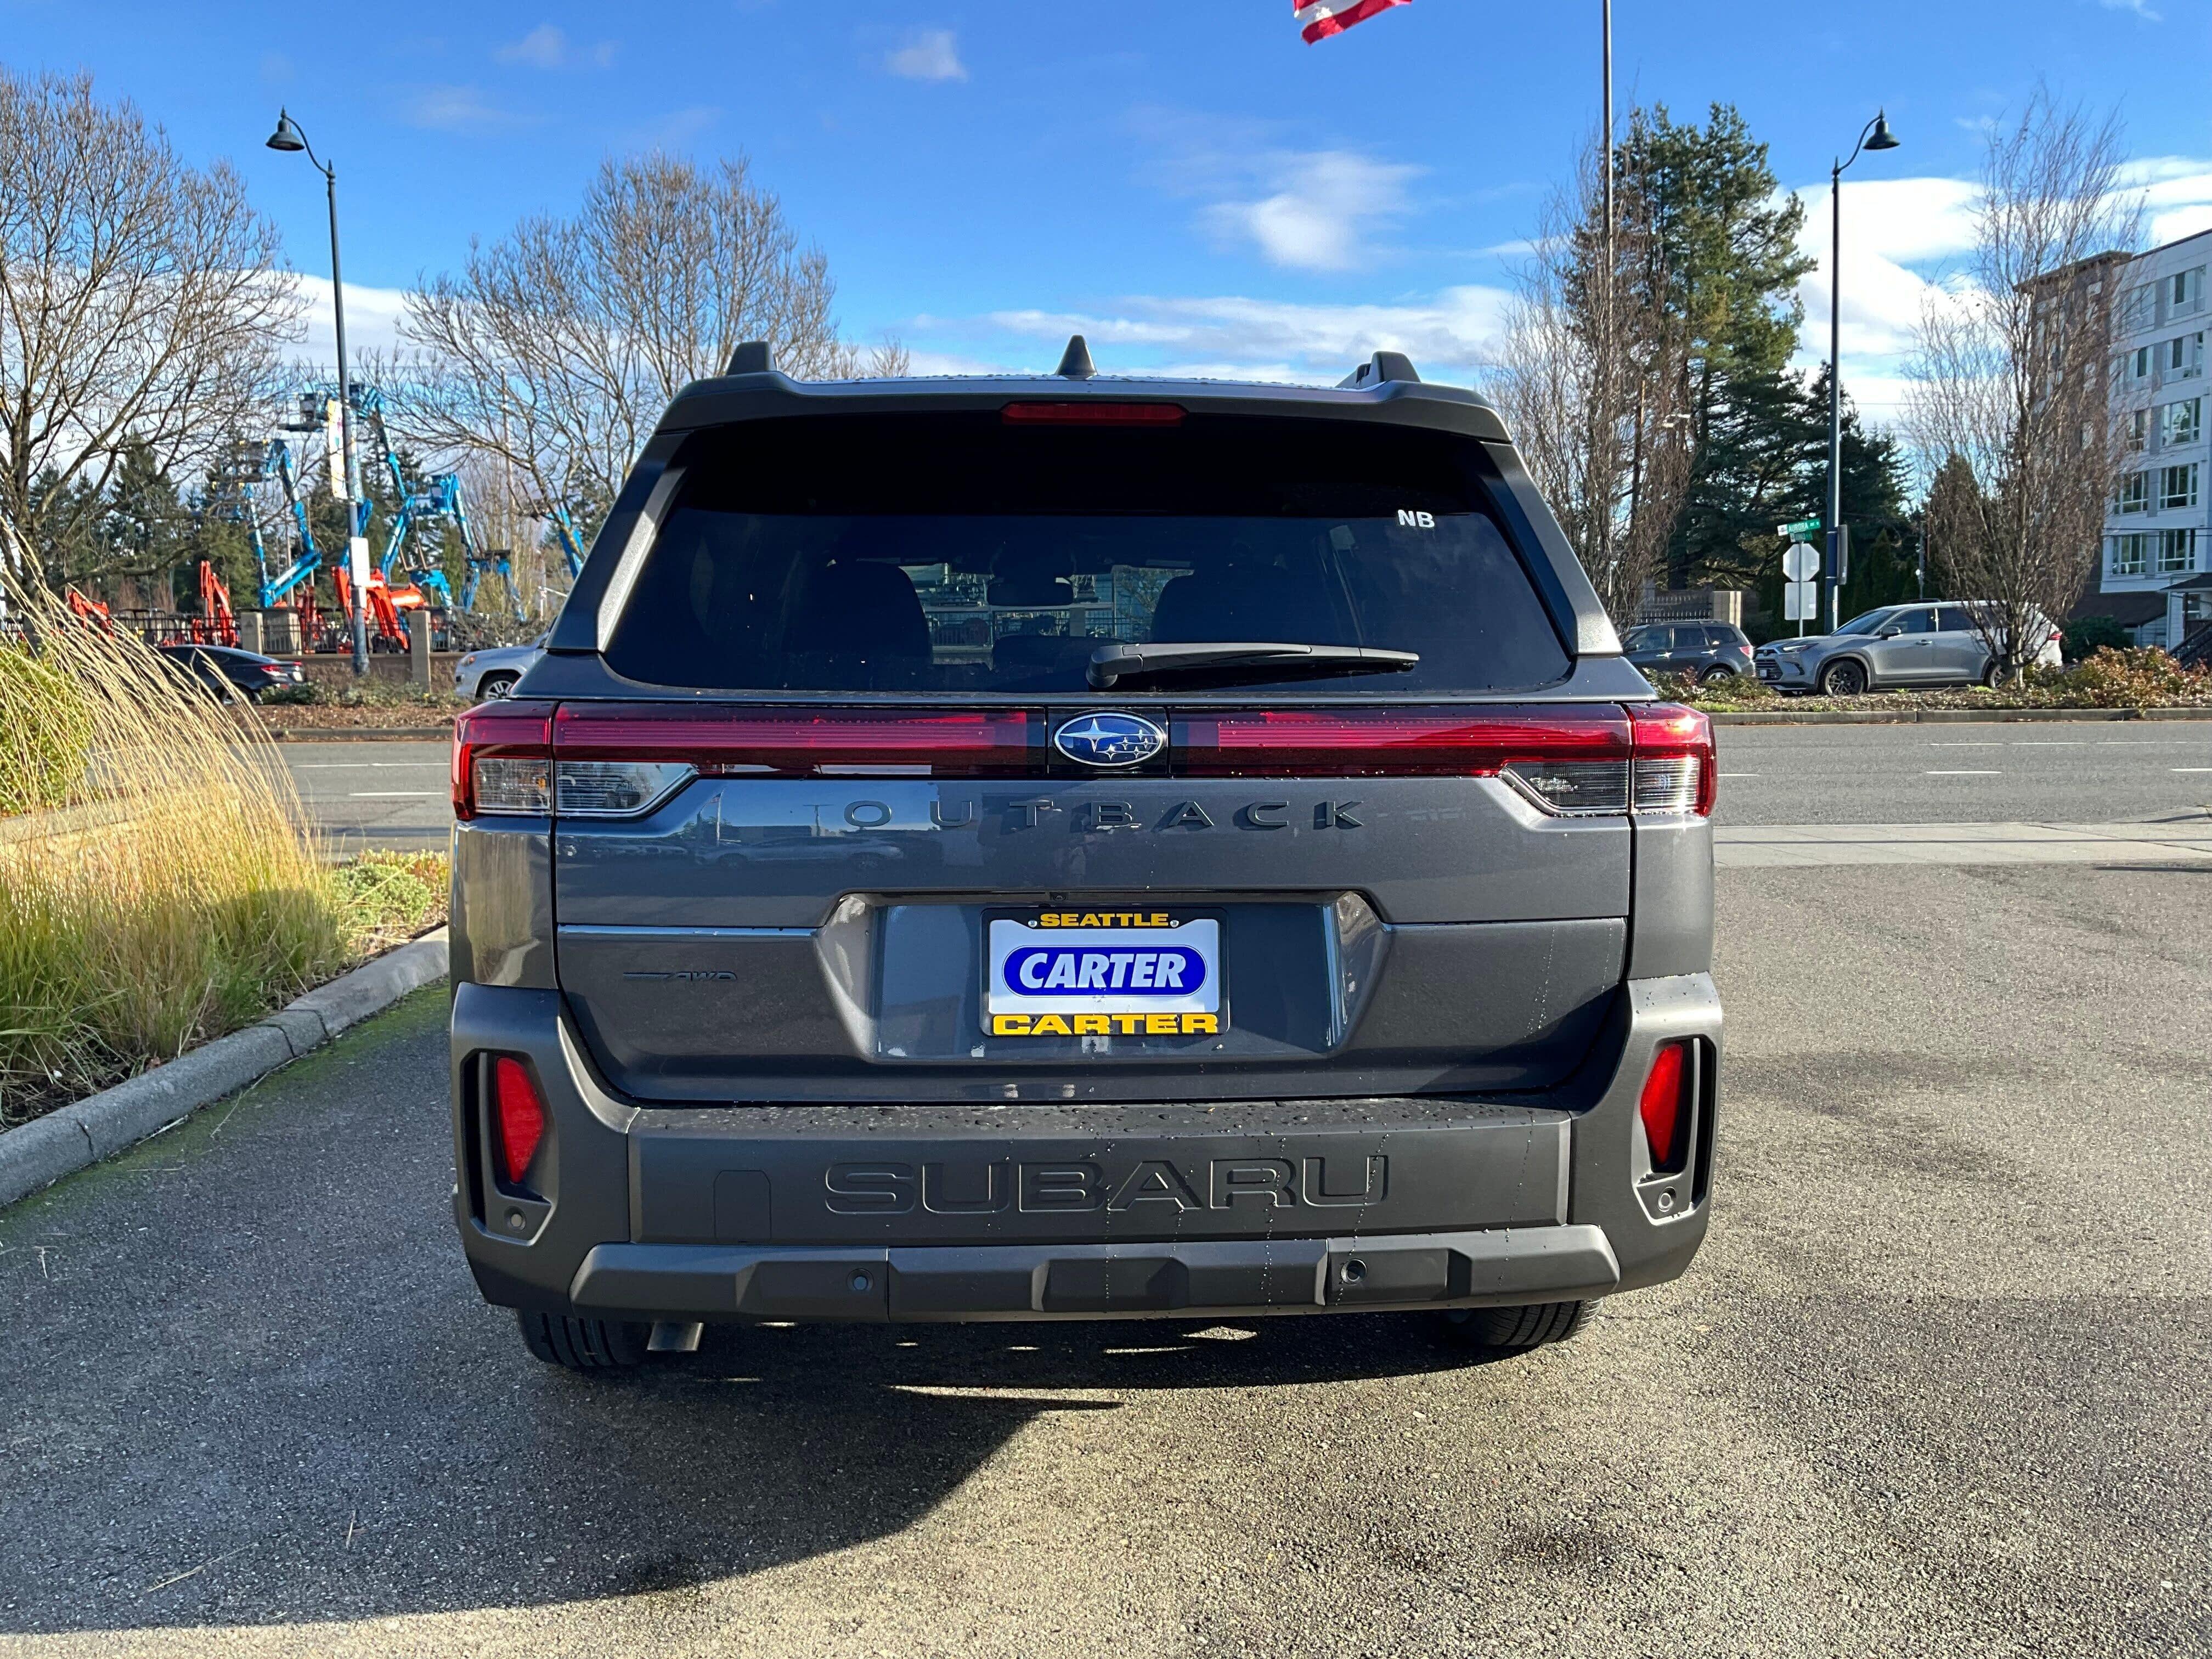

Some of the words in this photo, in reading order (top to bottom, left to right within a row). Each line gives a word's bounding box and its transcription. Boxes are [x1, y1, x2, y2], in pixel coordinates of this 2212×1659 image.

[1397, 509, 1435, 528] NB
[1788, 522, 1808, 532] AURORA
[843, 800, 1364, 827] OUTBACK
[1040, 913, 1169, 927] SEATTLE
[674, 971, 738, 981] AWD
[1019, 952, 1187, 989] CARTER
[993, 1014, 1218, 1035] CARTER
[825, 1155, 1389, 1214] SUBARU
